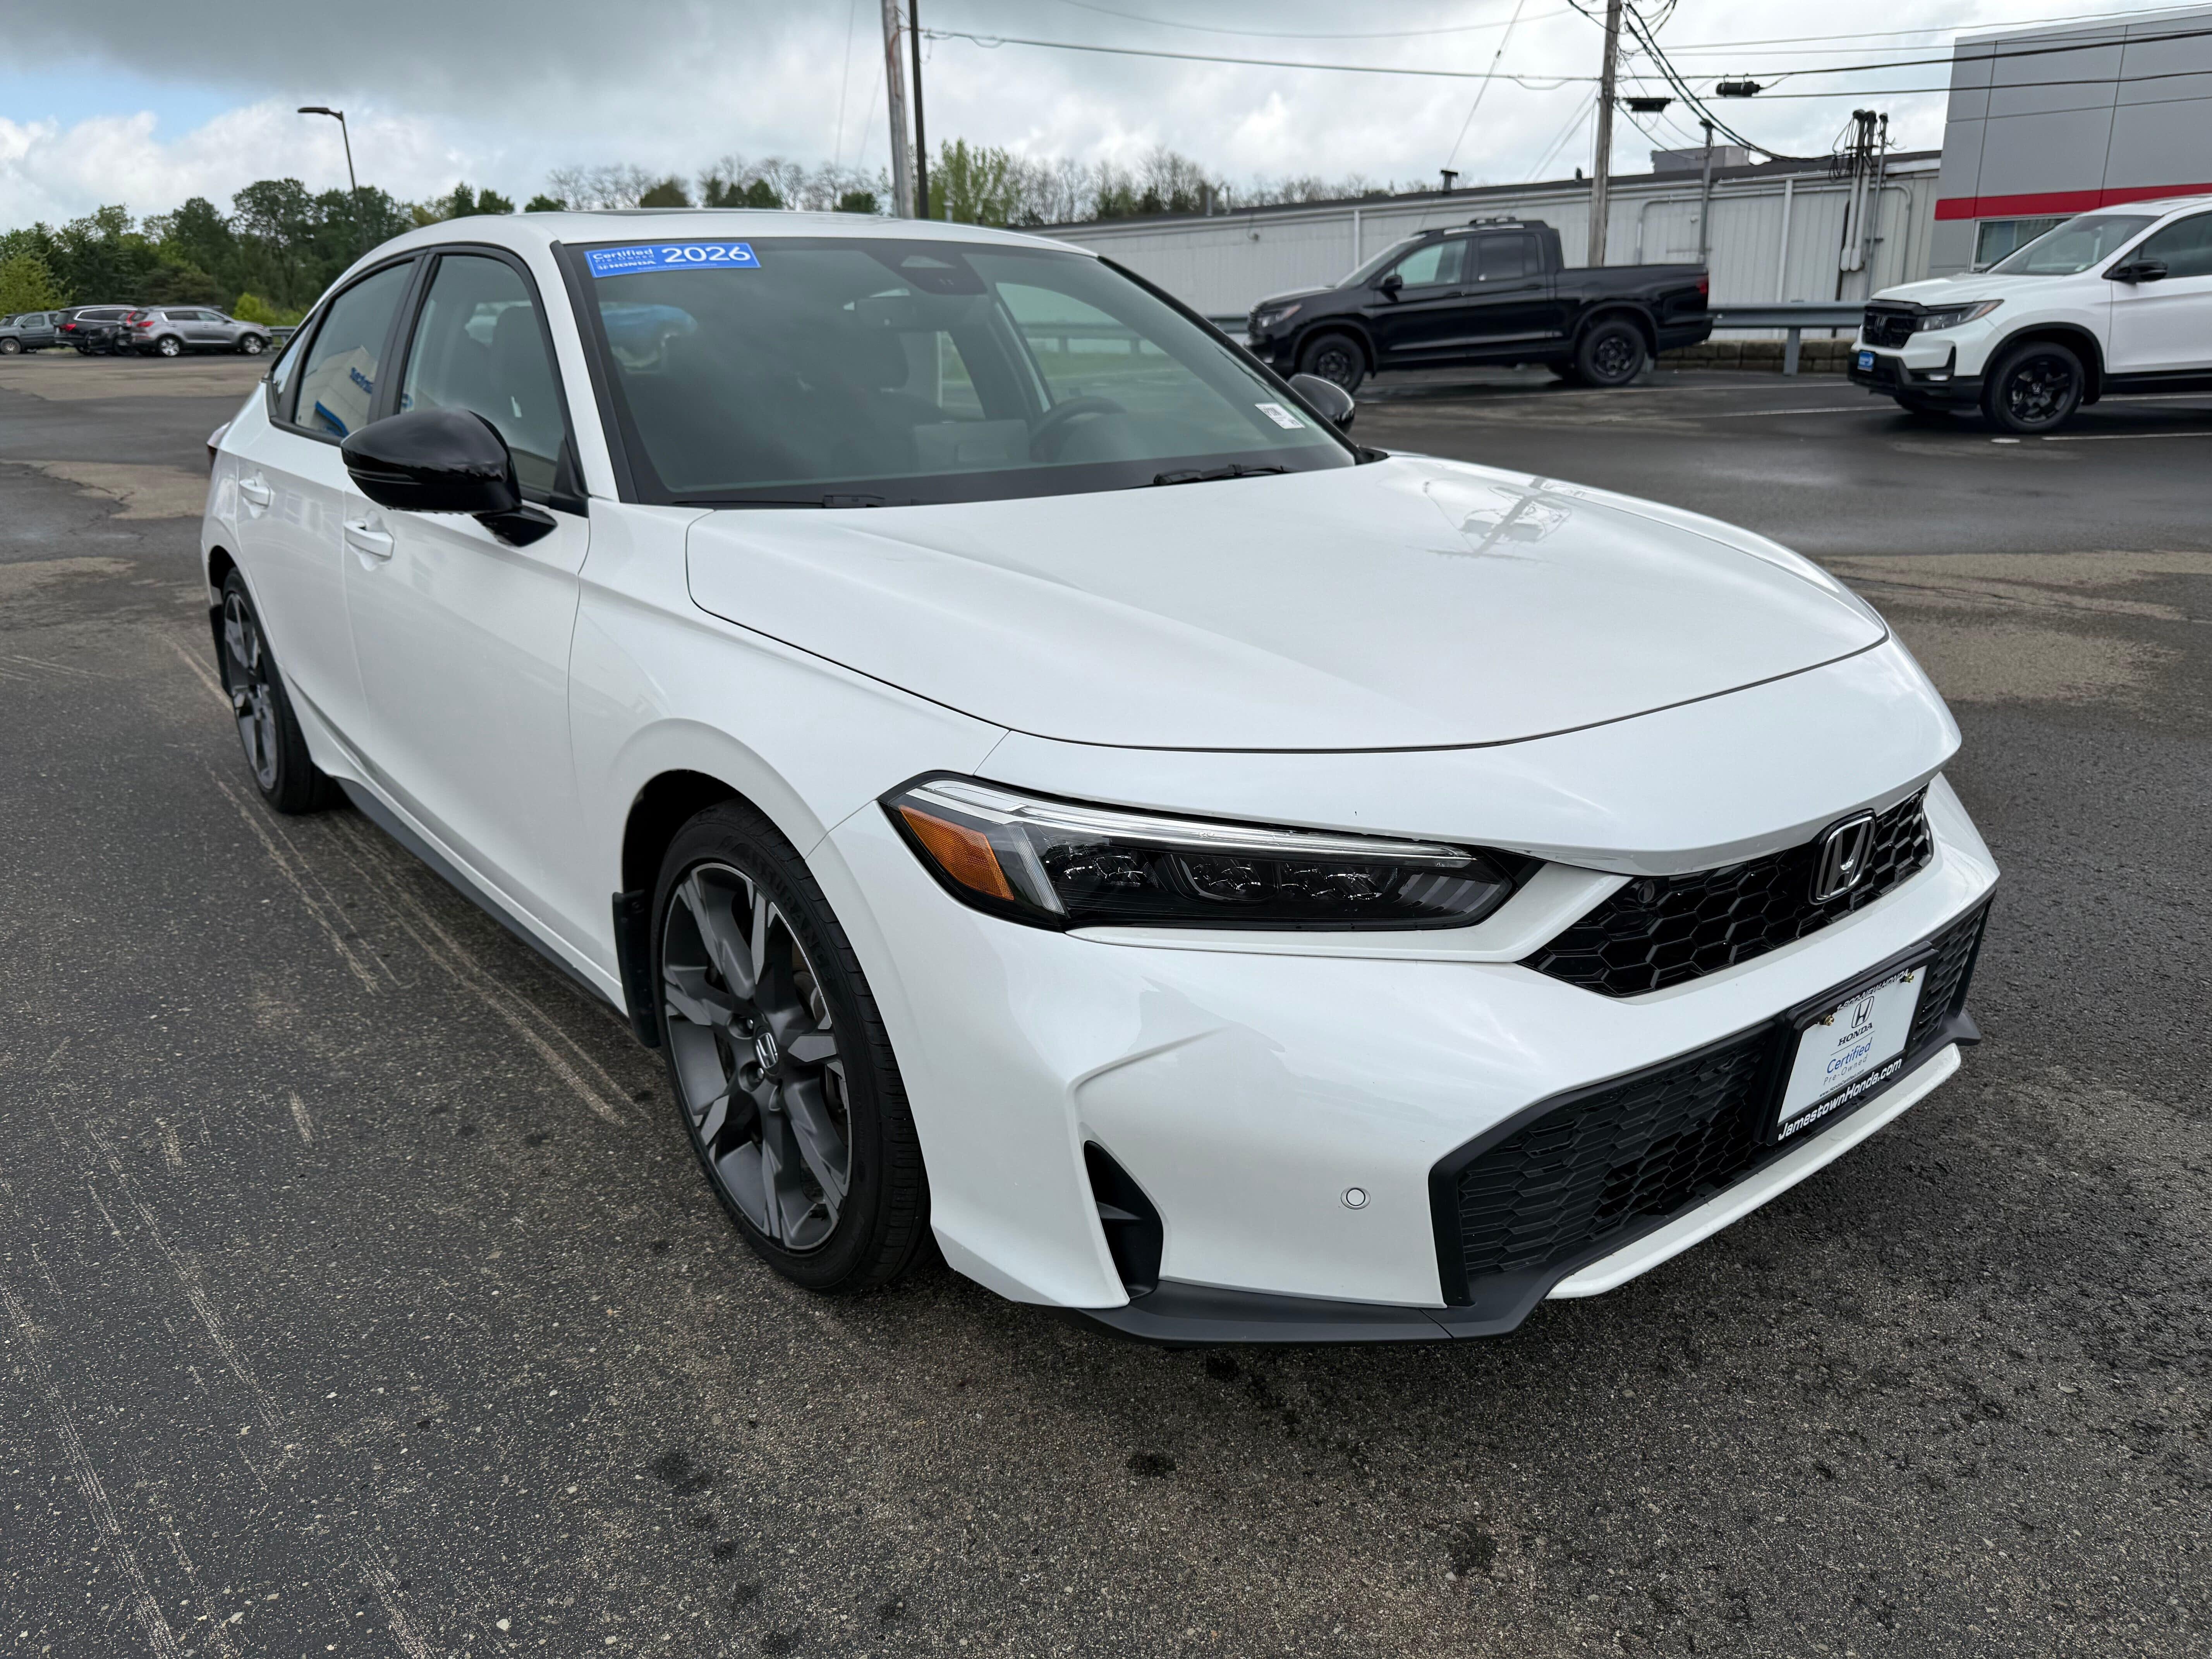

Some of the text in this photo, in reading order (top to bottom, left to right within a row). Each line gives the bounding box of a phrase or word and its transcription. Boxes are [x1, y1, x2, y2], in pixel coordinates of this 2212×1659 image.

[593, 247, 653, 260] Certified
[608, 260, 656, 269] HONDA
[661, 247, 750, 263] 2026
[1837, 1022, 1873, 1046] HONDA
[1827, 1037, 1873, 1073] Certified
[1823, 1054, 1868, 1085] Pre-Owned
[1778, 1058, 1902, 1141] JamestownHonda.com
